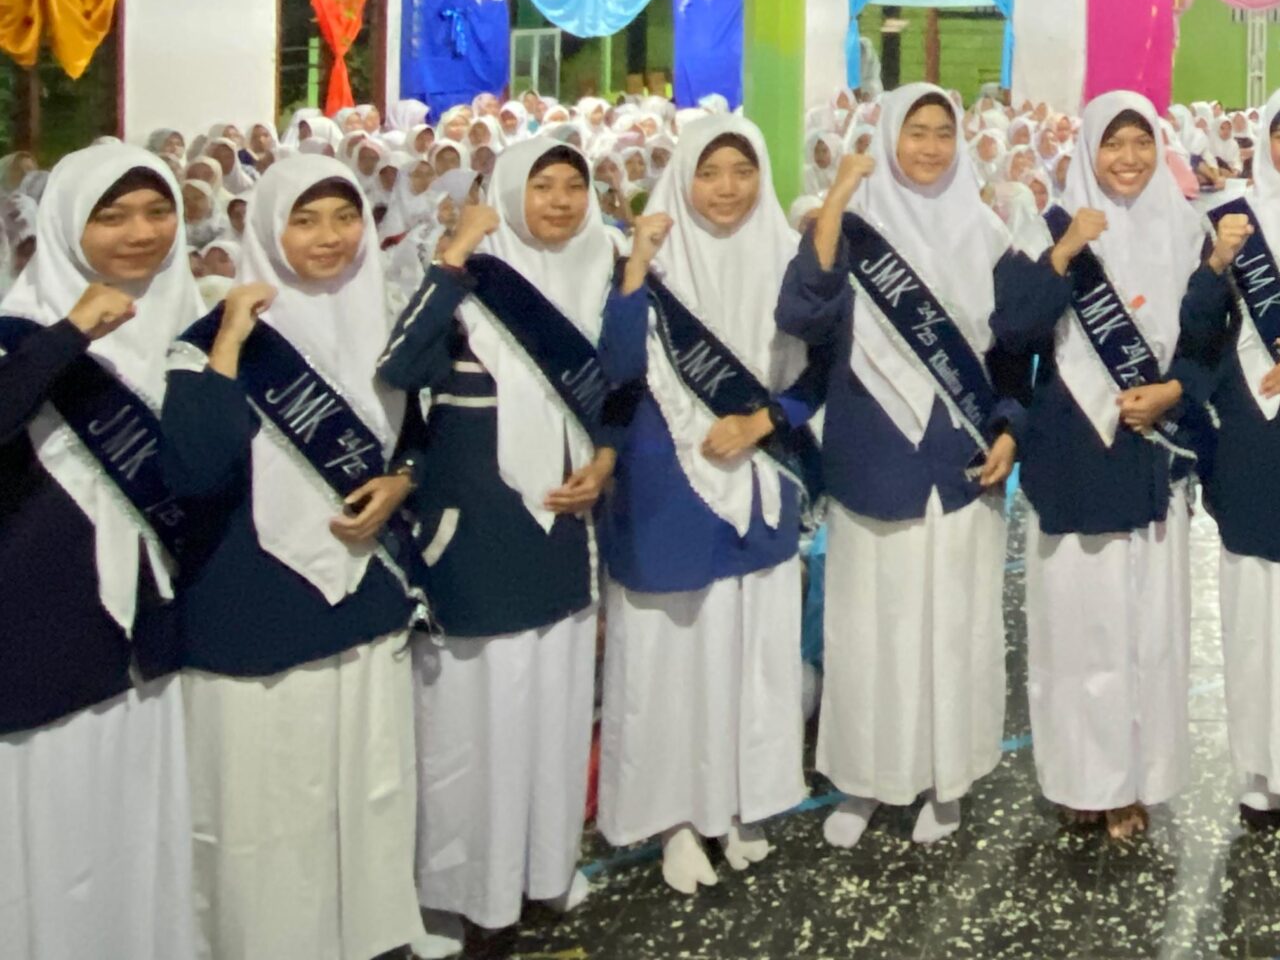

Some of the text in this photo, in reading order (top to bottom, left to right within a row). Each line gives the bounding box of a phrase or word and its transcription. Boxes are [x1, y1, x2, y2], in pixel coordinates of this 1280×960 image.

[859, 252, 920, 308] JMK
[911, 300, 947, 347] 24/25
[1072, 282, 1129, 344] JMK
[675, 339, 737, 399] JMK
[87, 403, 160, 481] JMK
[264, 372, 343, 444] JMK
